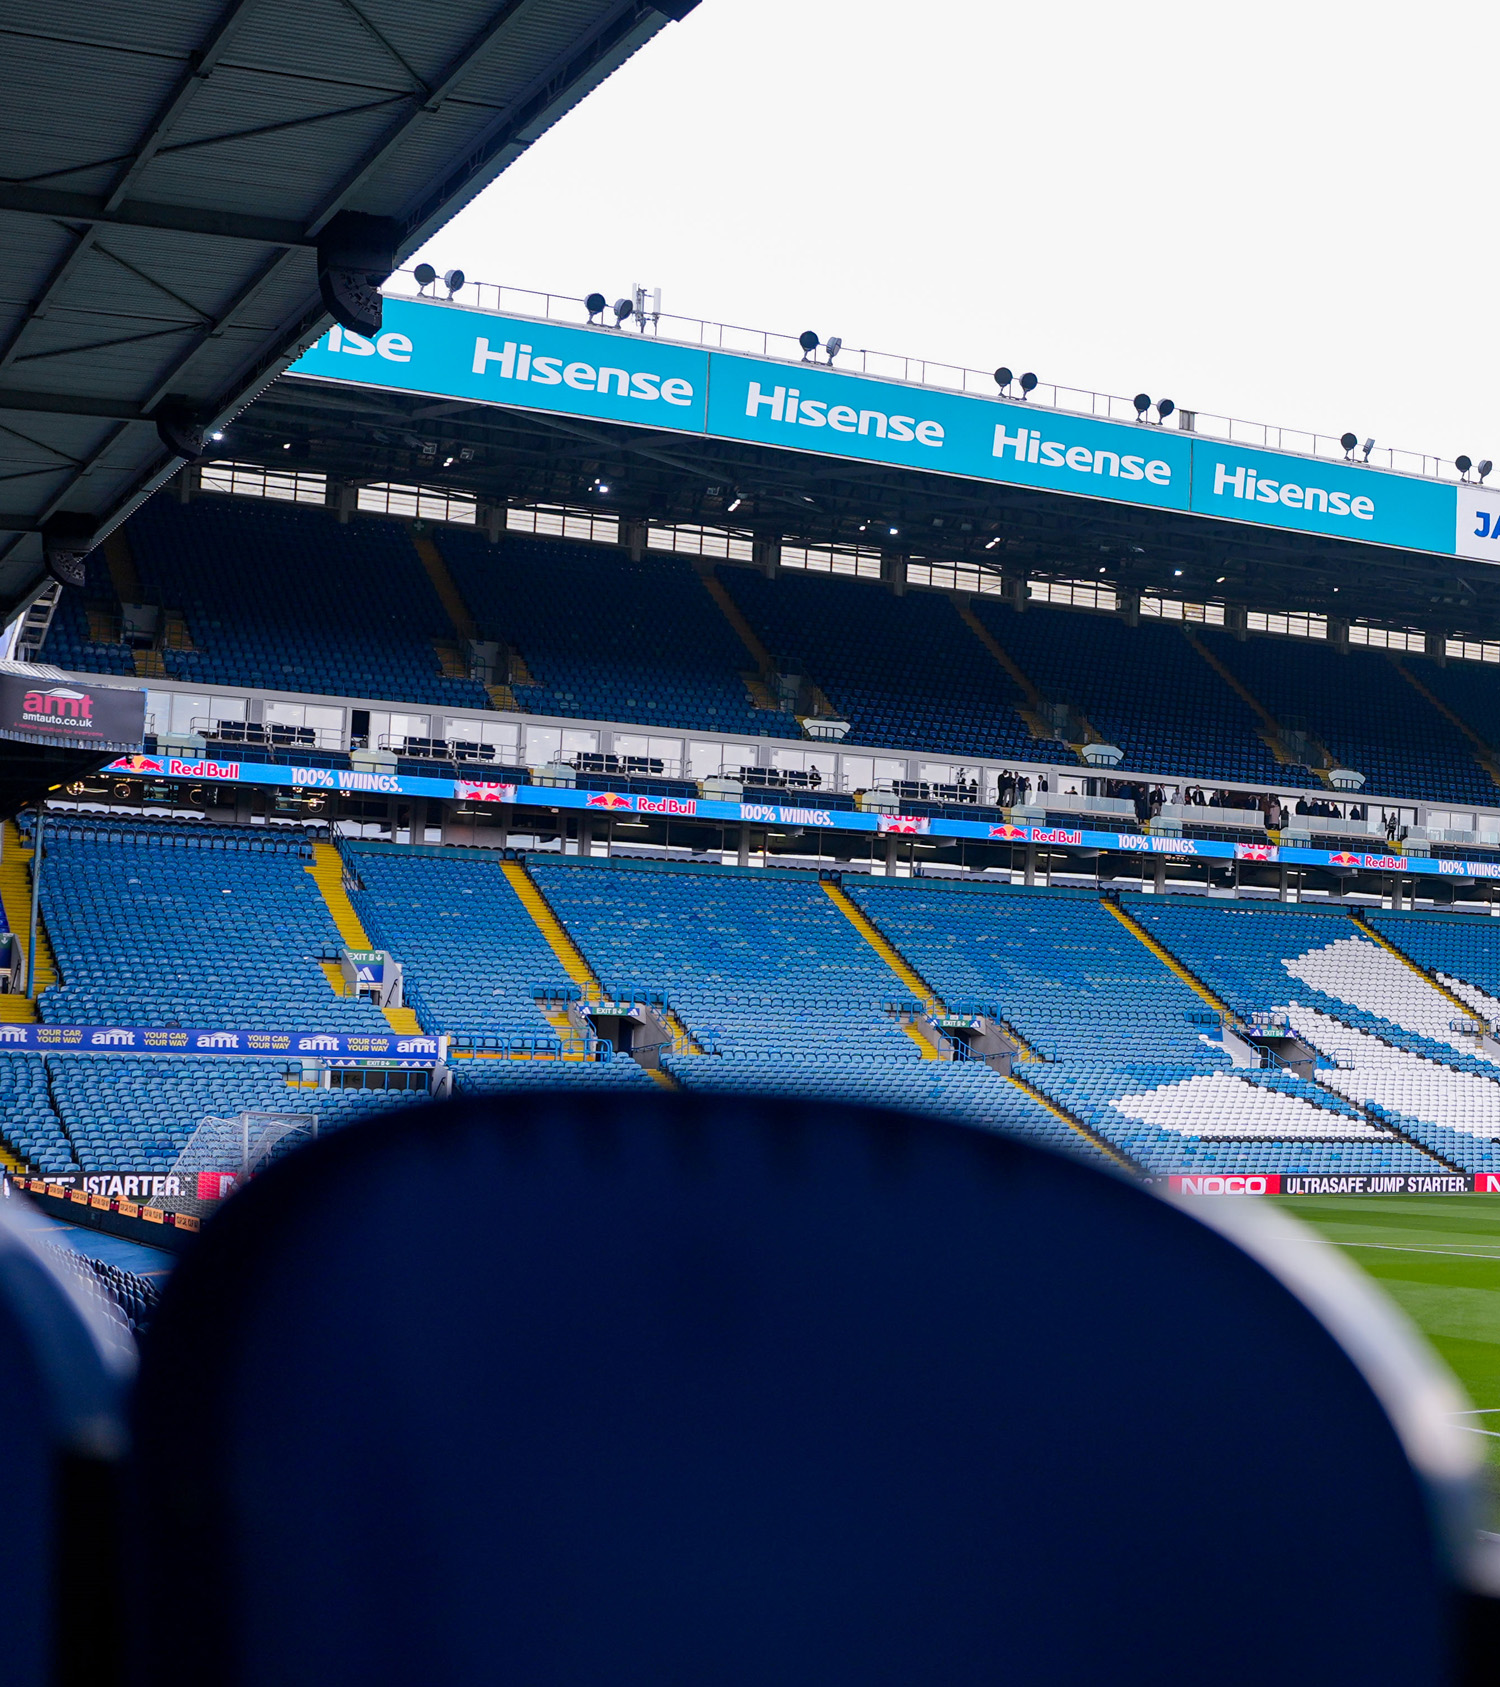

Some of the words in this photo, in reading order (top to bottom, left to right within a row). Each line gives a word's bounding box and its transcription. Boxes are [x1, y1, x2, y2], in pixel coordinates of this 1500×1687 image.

[471, 336, 694, 407] Hisense
[745, 381, 945, 448] Hisense
[992, 424, 1172, 486] Hisense
[1213, 463, 1374, 521] Hisense
[23, 692, 94, 719] amt
[22, 712, 93, 728] amtauto.co.uk
[170, 759, 203, 777] Red
[206, 762, 239, 779] Bull
[291, 768, 333, 787] 100%
[338, 771, 403, 792] WIIINGS.
[637, 797, 666, 812] Red
[668, 799, 696, 815] Bull
[740, 804, 776, 821] 100%
[1032, 828, 1057, 843] Red
[1058, 830, 1081, 845] Bull
[1118, 834, 1148, 850] 100%
[1364, 855, 1386, 868] Red
[1387, 856, 1407, 870] Bull
[1438, 860, 1464, 875] 100%
[0, 1028, 27, 1042] mt
[92, 1032, 135, 1046] amt
[144, 1031, 168, 1039] YOUR
[168, 1039, 188, 1047] WAY
[197, 1035, 239, 1048] amt
[347, 1037, 370, 1045] YOUR
[271, 1042, 290, 1050] WAY
[298, 1037, 339, 1051] amt
[347, 1044, 370, 1052] YOUR
[396, 1040, 436, 1054] amt
[1181, 1176, 1266, 1195] NOCO
[1367, 1177, 1405, 1193] JUMP
